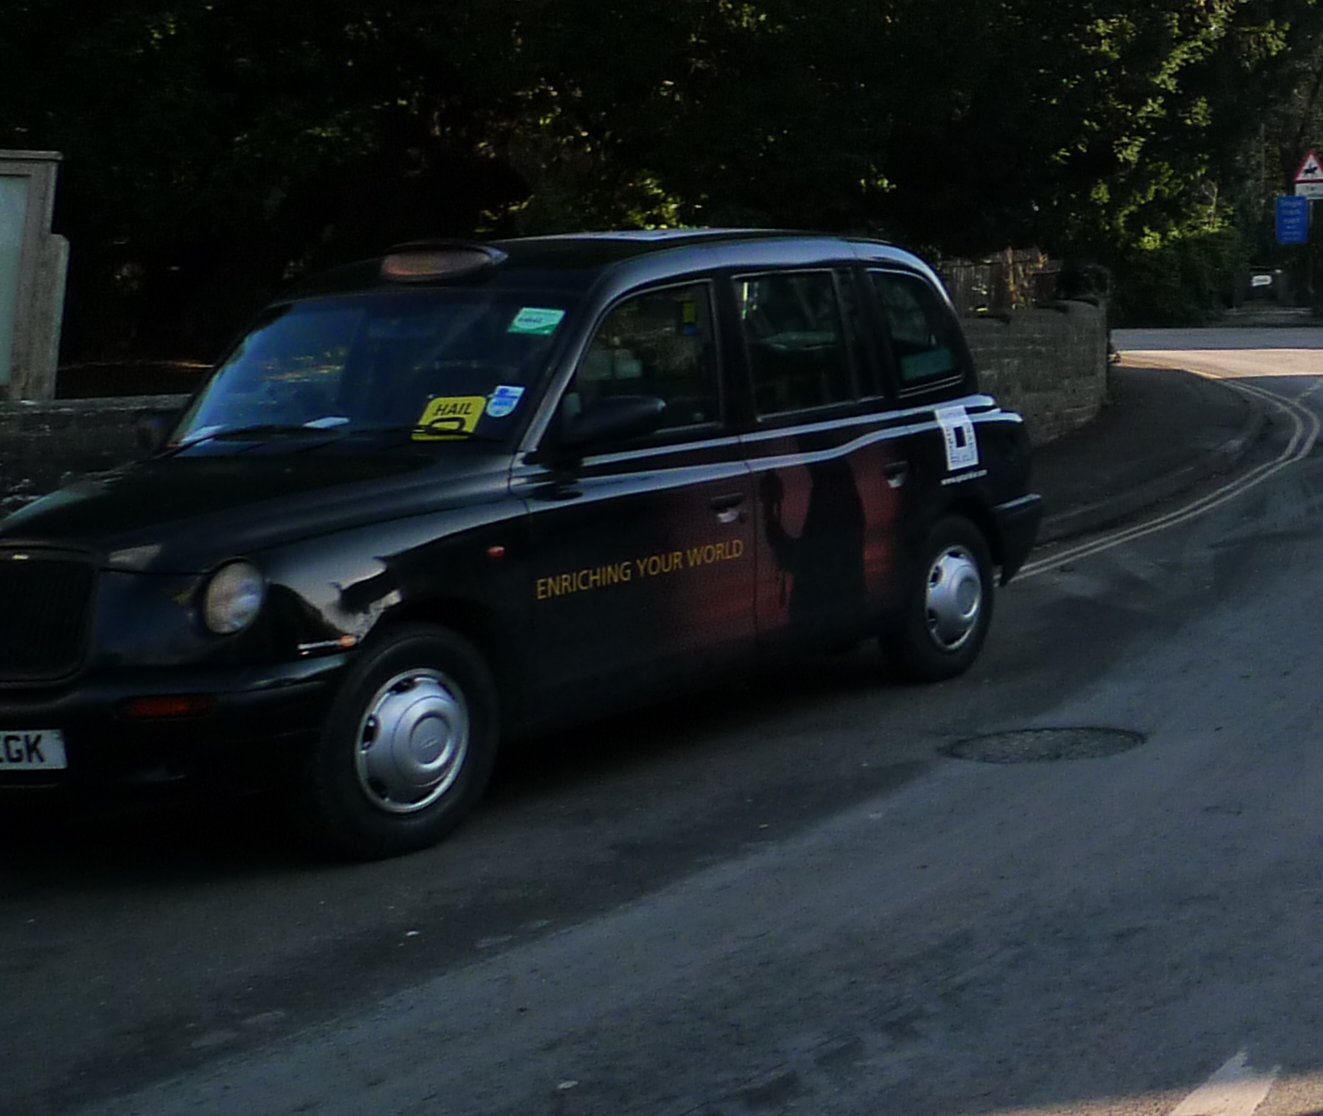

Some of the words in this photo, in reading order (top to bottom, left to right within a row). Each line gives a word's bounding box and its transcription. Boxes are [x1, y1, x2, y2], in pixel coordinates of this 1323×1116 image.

[432, 402, 472, 416] HAIL
[536, 560, 633, 601] ENRICHING
[636, 550, 684, 578] YOUR
[686, 539, 744, 568] WORLD
